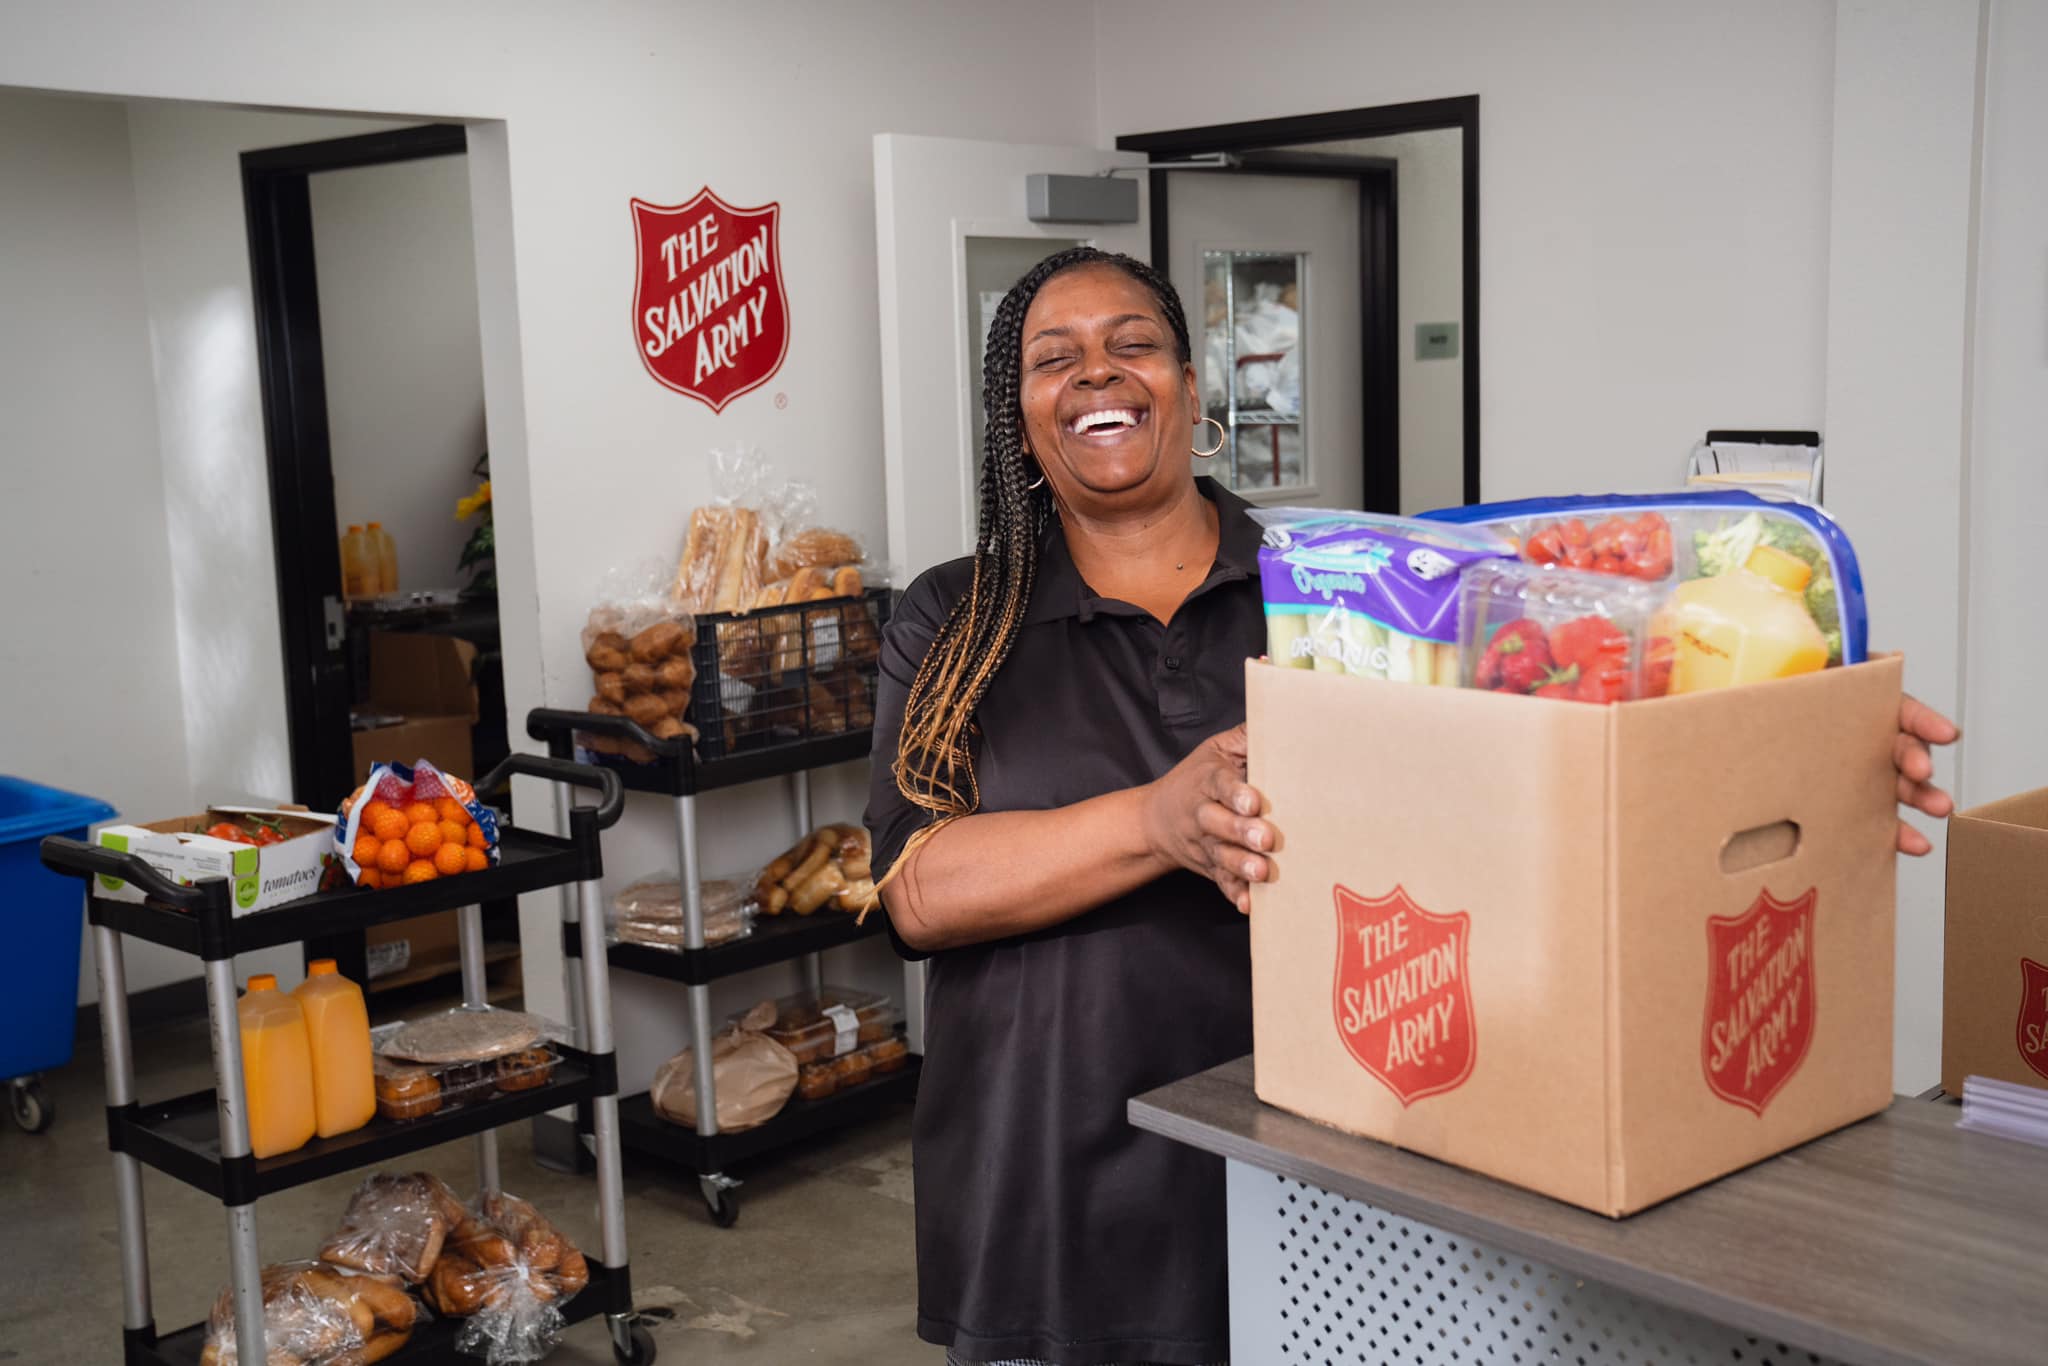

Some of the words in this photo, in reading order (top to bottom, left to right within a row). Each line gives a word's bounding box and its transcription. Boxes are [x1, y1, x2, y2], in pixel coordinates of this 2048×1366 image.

[645, 224, 769, 357] SALVATION
[661, 213, 719, 282] THE
[693, 285, 768, 387] ARMY
[1343, 932, 1457, 1034] SALVATION
[1358, 911, 1409, 968] THE
[1727, 913, 1770, 992] THE
[1385, 993, 1455, 1072] ARMY
[1710, 913, 1806, 1072] SALVATION
[1744, 974, 1802, 1090] ARMY
